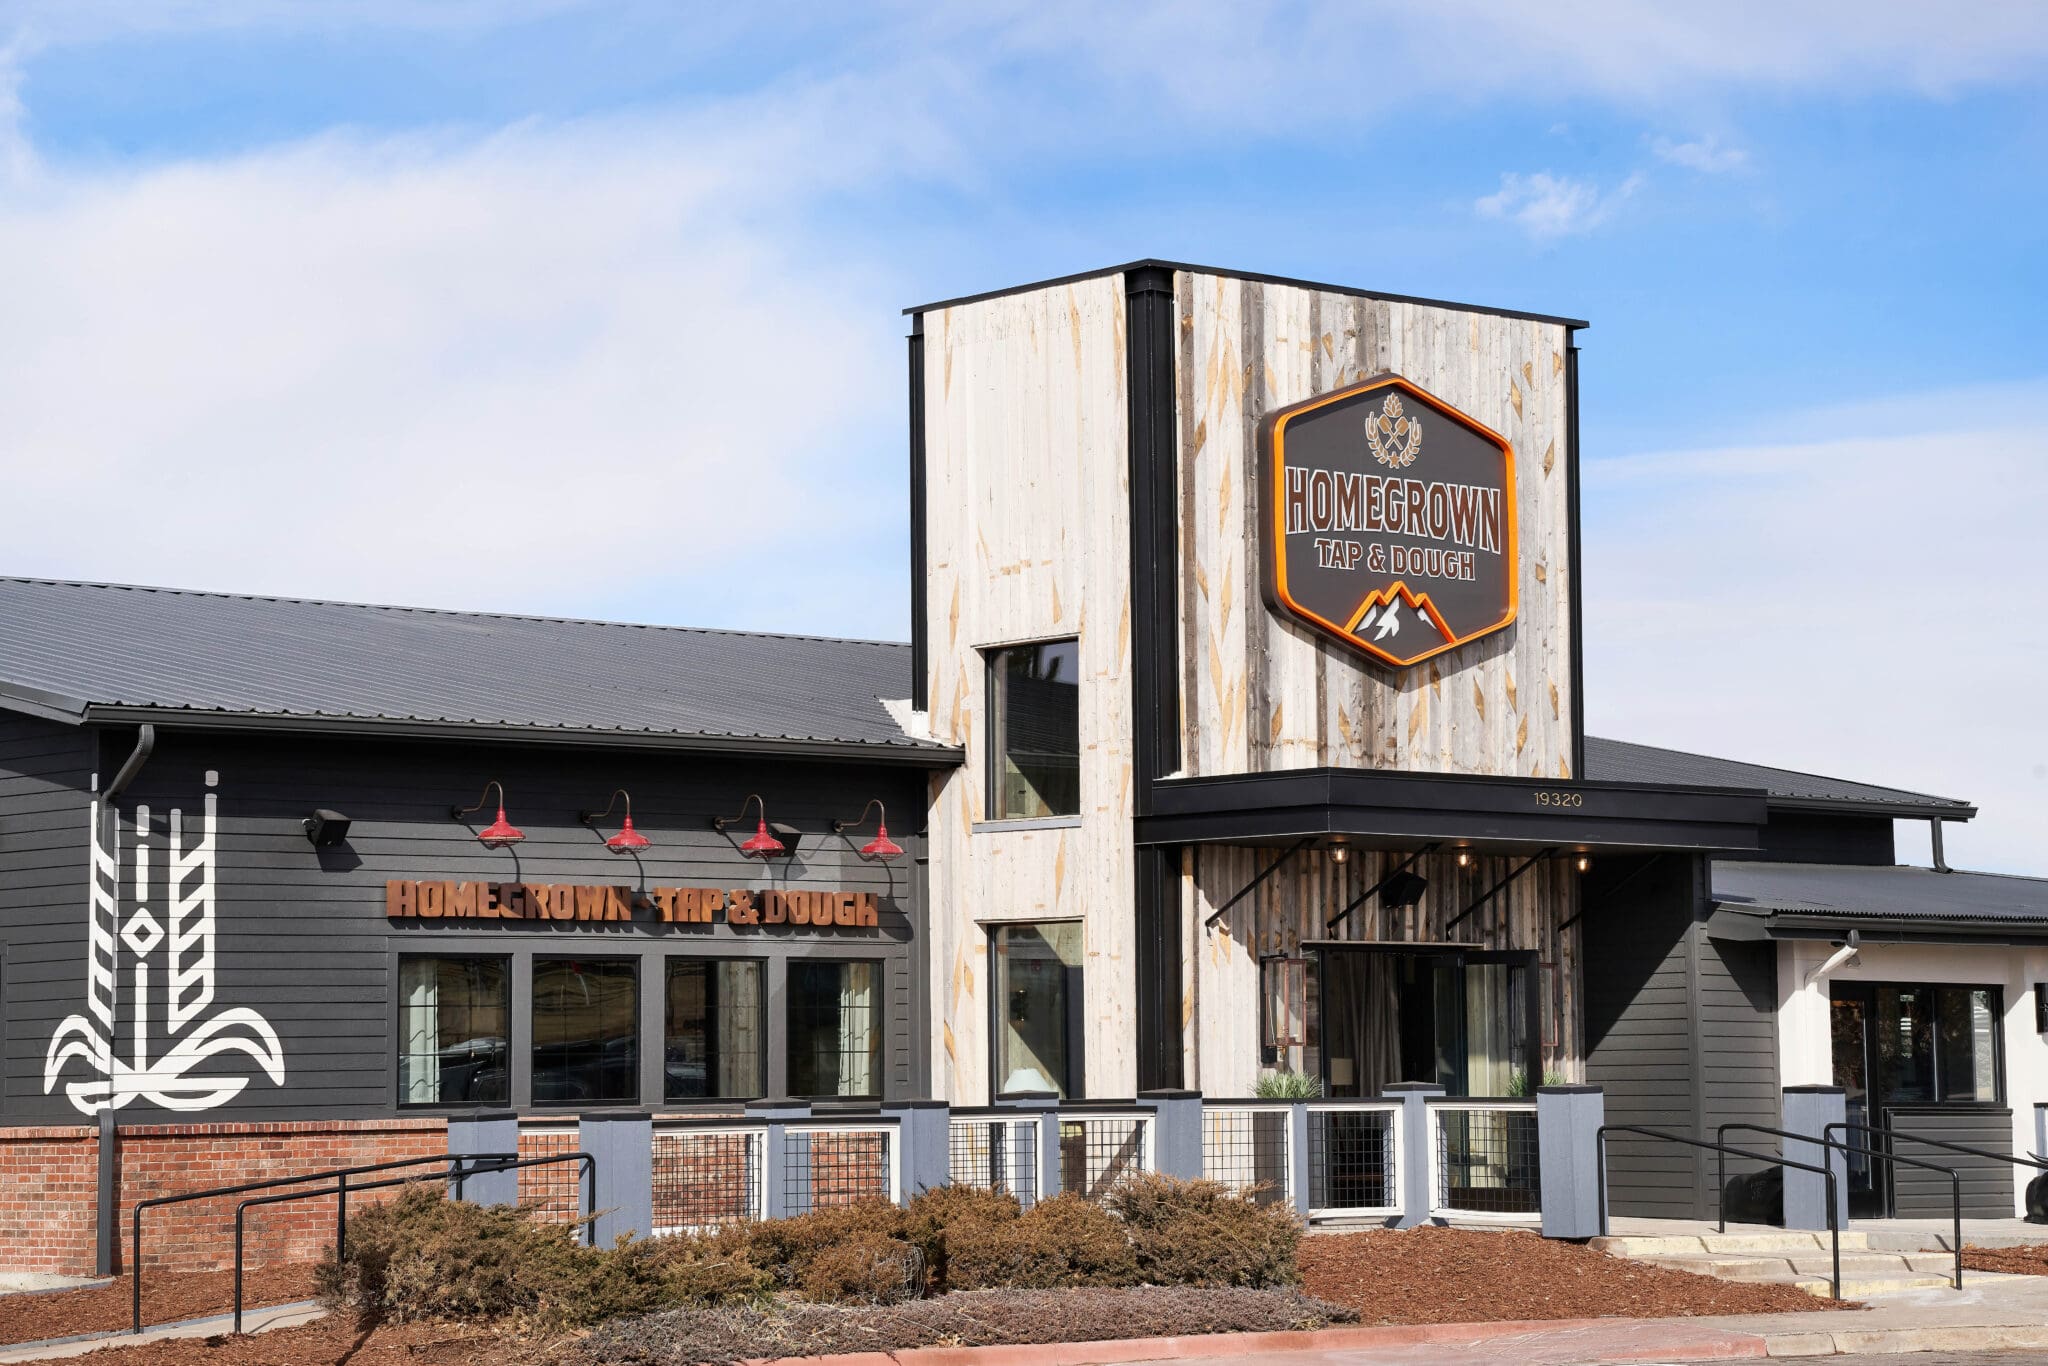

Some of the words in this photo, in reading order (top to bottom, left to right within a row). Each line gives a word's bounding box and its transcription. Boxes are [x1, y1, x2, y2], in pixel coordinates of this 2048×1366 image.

[1285, 466, 1501, 554] HOMEGROWN
[1314, 538, 1362, 570] TAP
[1367, 543, 1387, 573] &
[1391, 545, 1476, 581] DOUGH
[1534, 792, 1582, 807] 19320
[386, 880, 632, 921] HOMEGROWN
[653, 887, 724, 923] TAP
[728, 889, 760, 925] &
[762, 890, 879, 927] DOUGH
